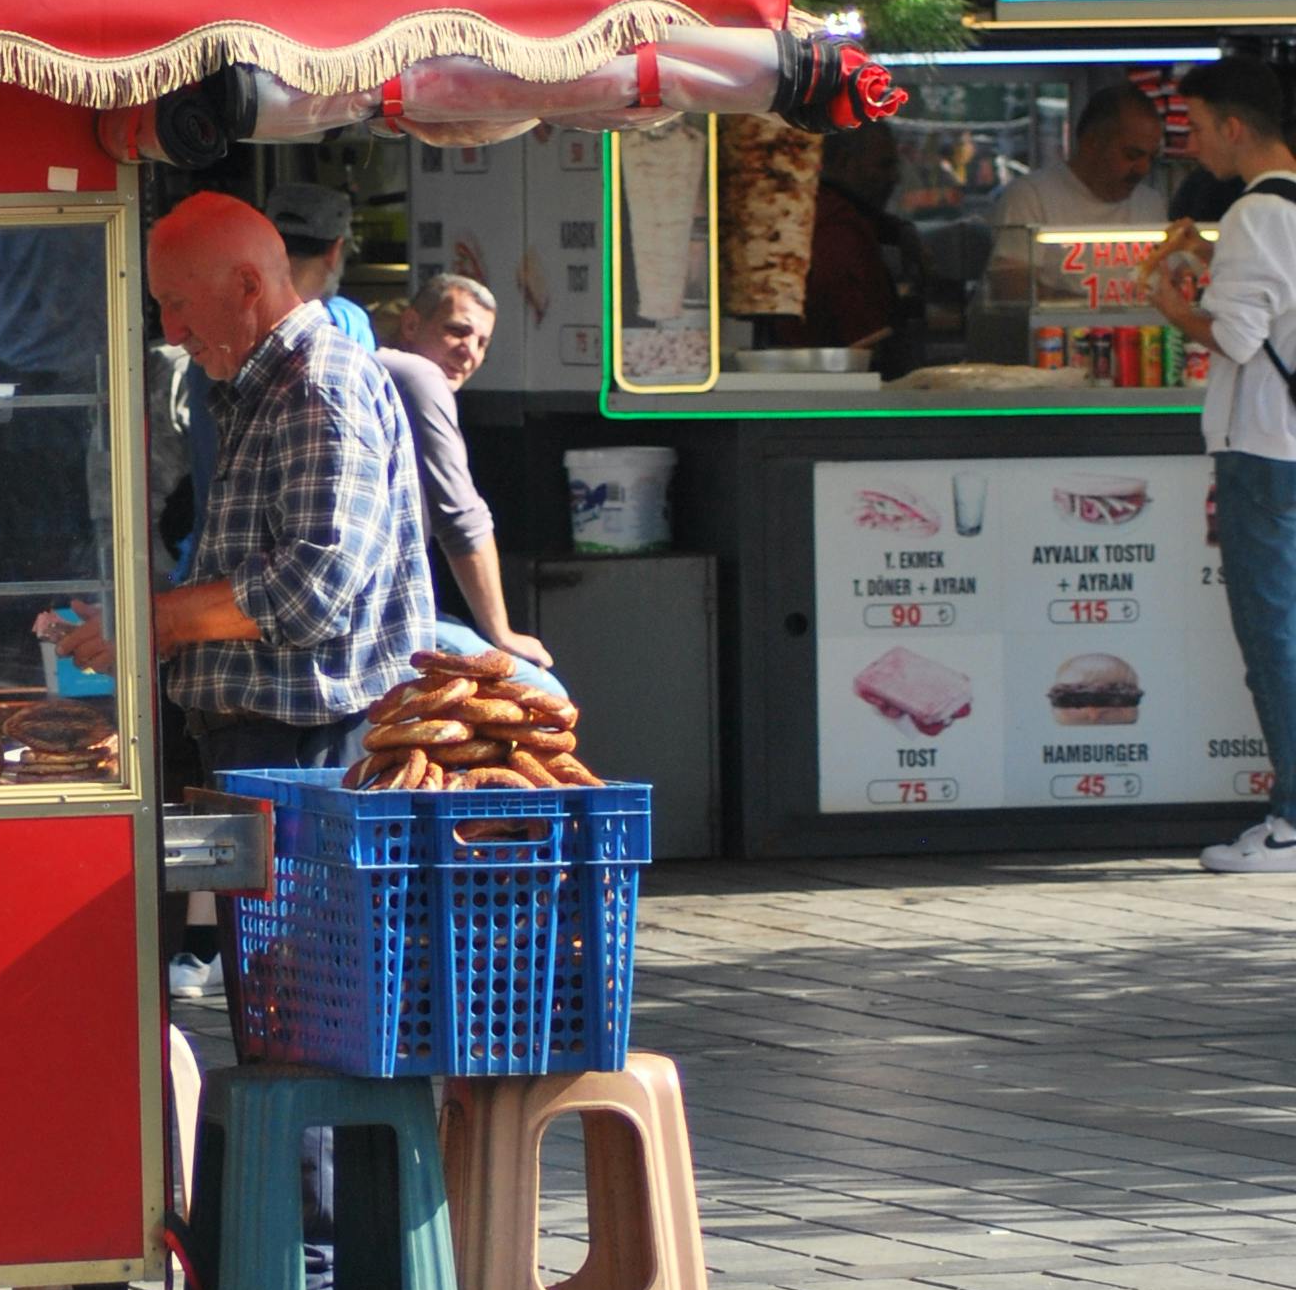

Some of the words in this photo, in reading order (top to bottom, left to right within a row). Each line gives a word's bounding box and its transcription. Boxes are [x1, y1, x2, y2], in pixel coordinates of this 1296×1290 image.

[1061, 242, 1085, 272] 2
[1082, 273, 1099, 310] 1
[900, 551, 944, 568] EKMEK
[1032, 545, 1099, 564] AYVALIK
[1105, 544, 1155, 562] TOSTU
[867, 575, 912, 596] DÖNER
[932, 577, 977, 595] AYRAN
[1058, 578, 1069, 592] +
[1077, 573, 1133, 592] AYRAN
[1202, 567, 1212, 585] 2
[891, 604, 921, 627] 90
[1070, 600, 1108, 623] 115
[897, 748, 937, 767] TOST
[1043, 744, 1148, 764] HAMBURGER
[898, 782, 927, 803] 75
[1076, 775, 1105, 797] 45
